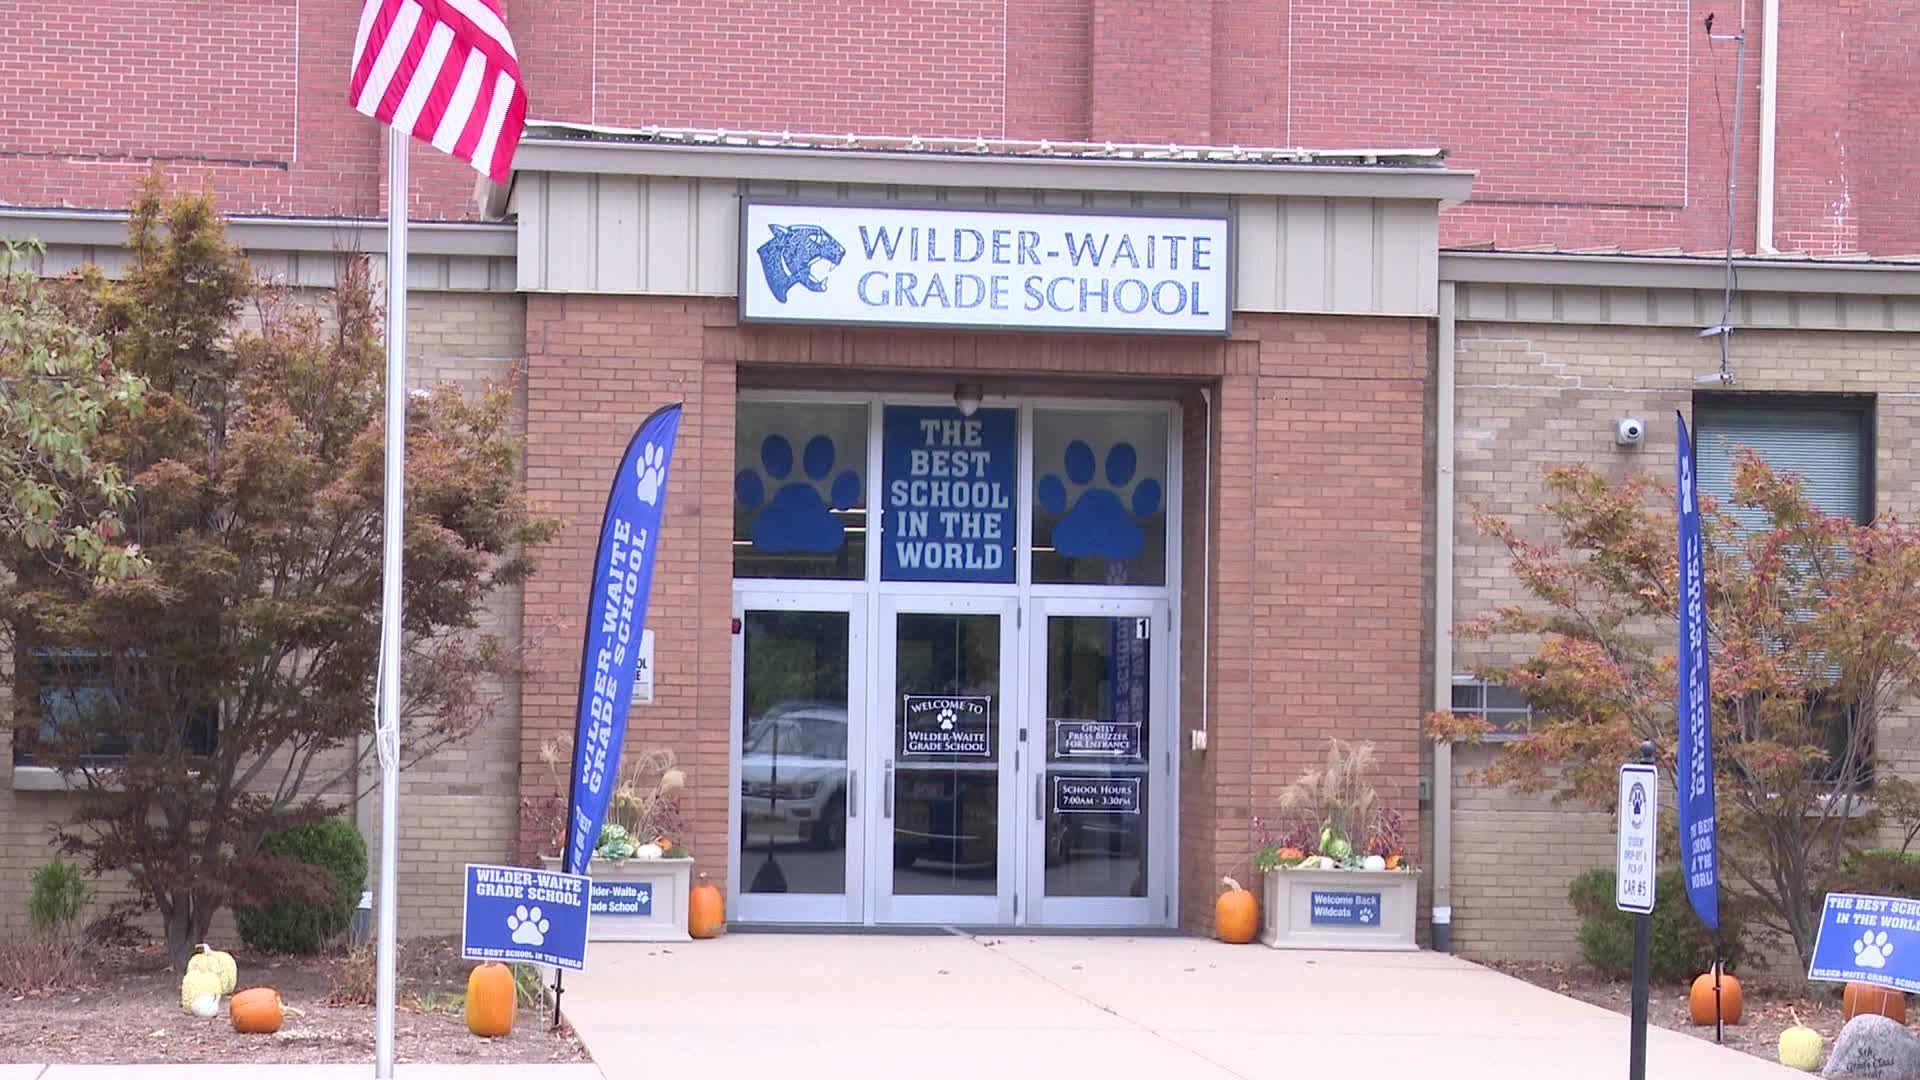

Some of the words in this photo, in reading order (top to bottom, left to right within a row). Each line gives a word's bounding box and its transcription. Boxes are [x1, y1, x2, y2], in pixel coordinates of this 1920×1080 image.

[858, 225, 1211, 272] WILDER-WAITE
[857, 271, 1010, 310] GRADE
[1024, 275, 1209, 316] SCHOOL
[920, 419, 982, 446] THE
[911, 450, 990, 477] BEST
[891, 480, 1009, 508] SCHOOL
[897, 511, 928, 537] IN
[940, 512, 1001, 538] THE
[896, 542, 1003, 569] WORLD
[1139, 620, 1146, 638] 1
[582, 518, 630, 784] WILDER-WAITE
[589, 680, 617, 794] GRADE
[614, 527, 647, 667] SCHOOL
[911, 700, 965, 713] WELCOME
[968, 702, 983, 715] TO
[908, 731, 985, 742] WILDER-WAITE
[1068, 732, 1094, 741] PRESS
[1095, 732, 1128, 741] BUZZER
[1081, 725, 1115, 733] GENTLY
[909, 741, 942, 751] GRADE
[945, 741, 985, 751] SCHOOL
[1065, 740, 1085, 748] FOR
[1085, 740, 1130, 749] ENTRANCE
[1062, 785, 1098, 794] SCHOOL
[1100, 785, 1132, 794] HOURS
[476, 869, 582, 893] WILDER-WAITE
[476, 883, 524, 898] GRADE
[527, 887, 581, 907] SCHOOL
[591, 886, 637, 896] ilder-Waite
[609, 901, 638, 912] School
[1314, 894, 1353, 904] Welcome
[1355, 895, 1377, 905] Back
[1829, 897, 1853, 909] THE
[1855, 898, 1888, 911] BEST
[1314, 906, 1352, 917] Wildcats
[1836, 912, 1850, 924] IN
[1853, 913, 1878, 926] THE
[467, 947, 482, 955] THE
[484, 948, 504, 956] BEST
[506, 950, 534, 959] SCHOOL
[544, 954, 558, 963] THE
[559, 958, 582, 968] WORLD
[1813, 968, 1866, 980] WILDER-WAITE
[1867, 973, 1894, 984] GRADE
